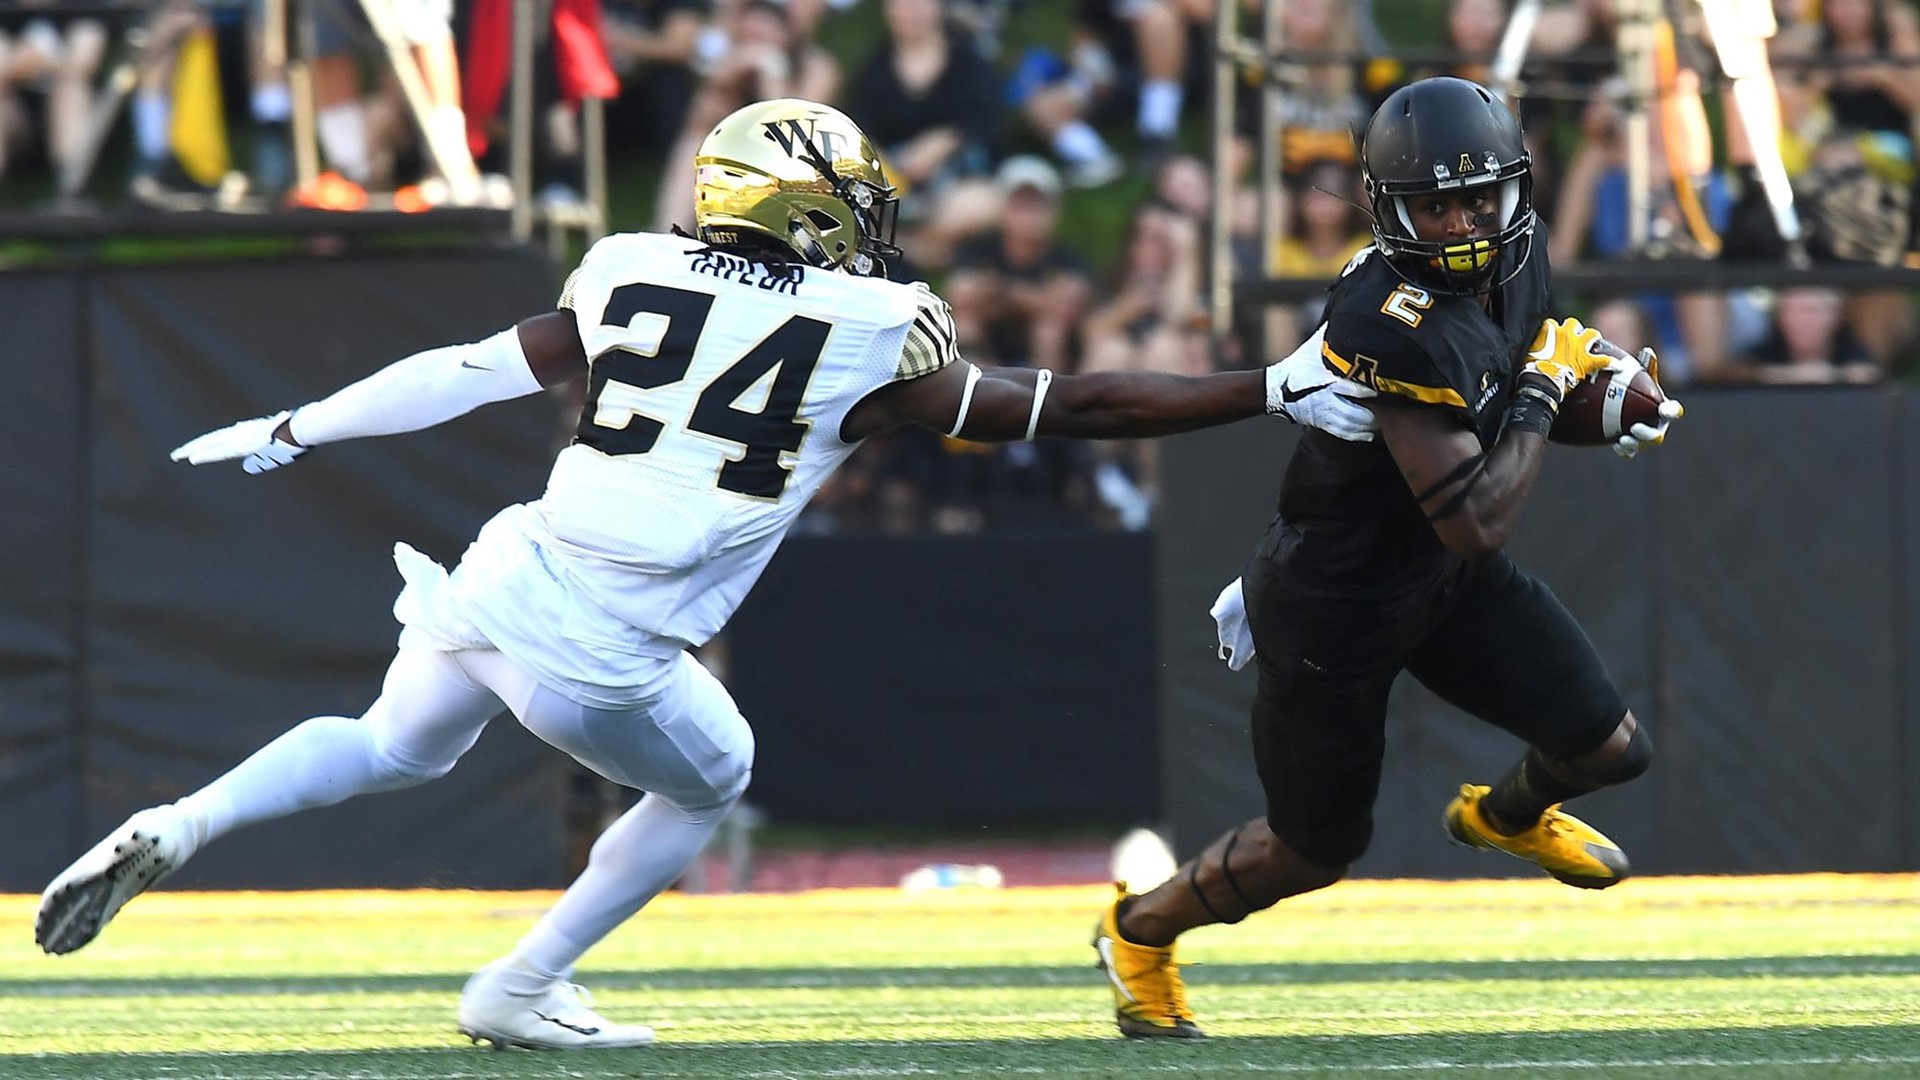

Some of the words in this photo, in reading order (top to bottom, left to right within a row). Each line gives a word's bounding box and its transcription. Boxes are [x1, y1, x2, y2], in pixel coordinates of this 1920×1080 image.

[1459, 153, 1475, 172] A
[1380, 282, 1435, 329] 2
[576, 282, 834, 503] 24
[1346, 352, 1379, 394] A
